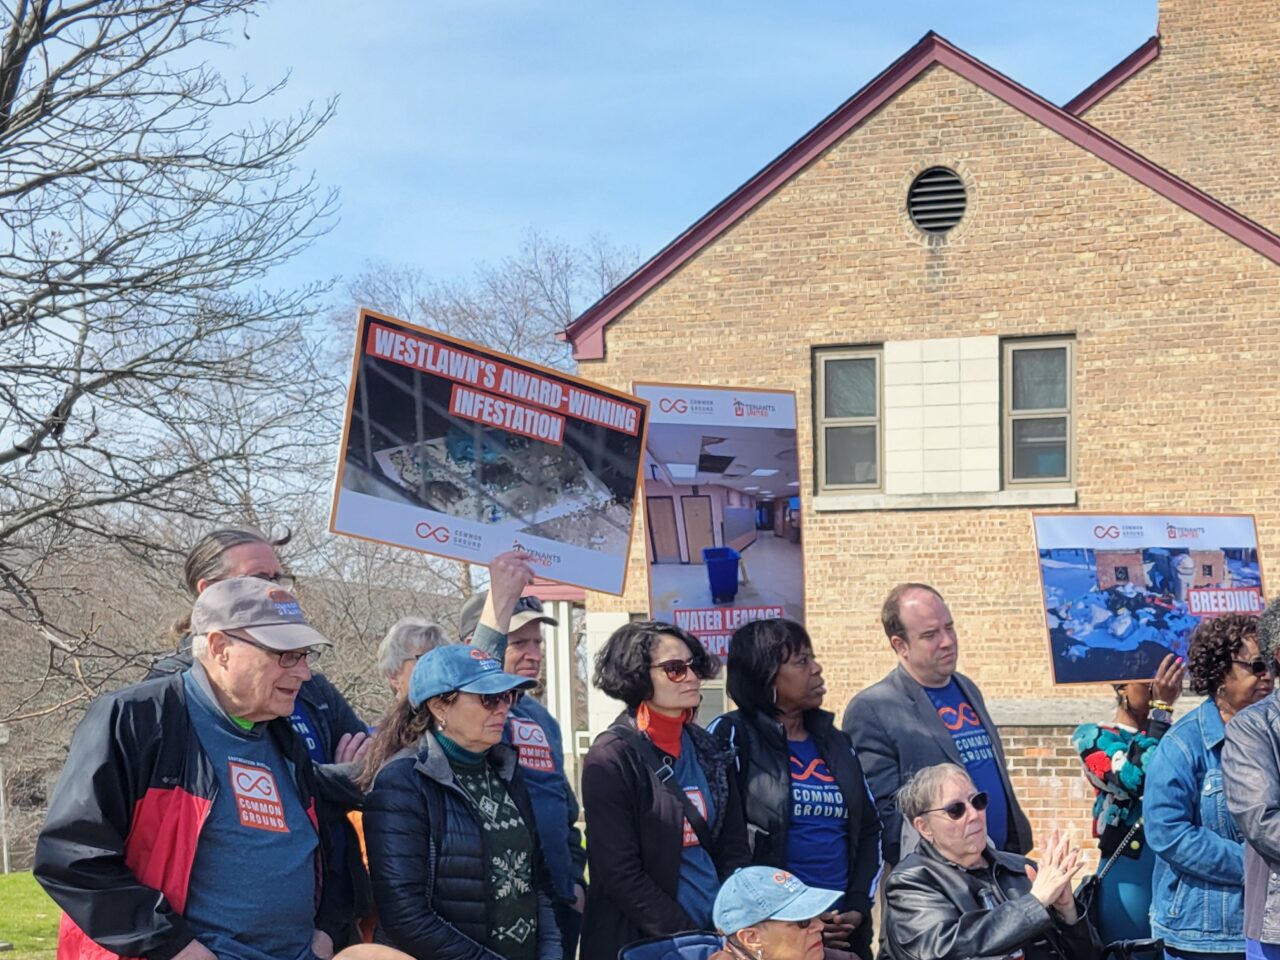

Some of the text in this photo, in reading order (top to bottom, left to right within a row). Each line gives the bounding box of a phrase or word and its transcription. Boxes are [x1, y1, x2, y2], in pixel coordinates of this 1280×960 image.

[374, 327, 637, 434] WESTLAWN'S AWARD-WINNING
[453, 388, 562, 442] INFESTATION
[525, 548, 562, 564] TENANTS
[1190, 590, 1260, 614] BREEDING
[675, 610, 723, 631] WATER
[955, 735, 992, 751] COMMO
[519, 747, 551, 759] OMMON
[239, 797, 282, 816] COMMON
[241, 810, 285, 828] GROUND
